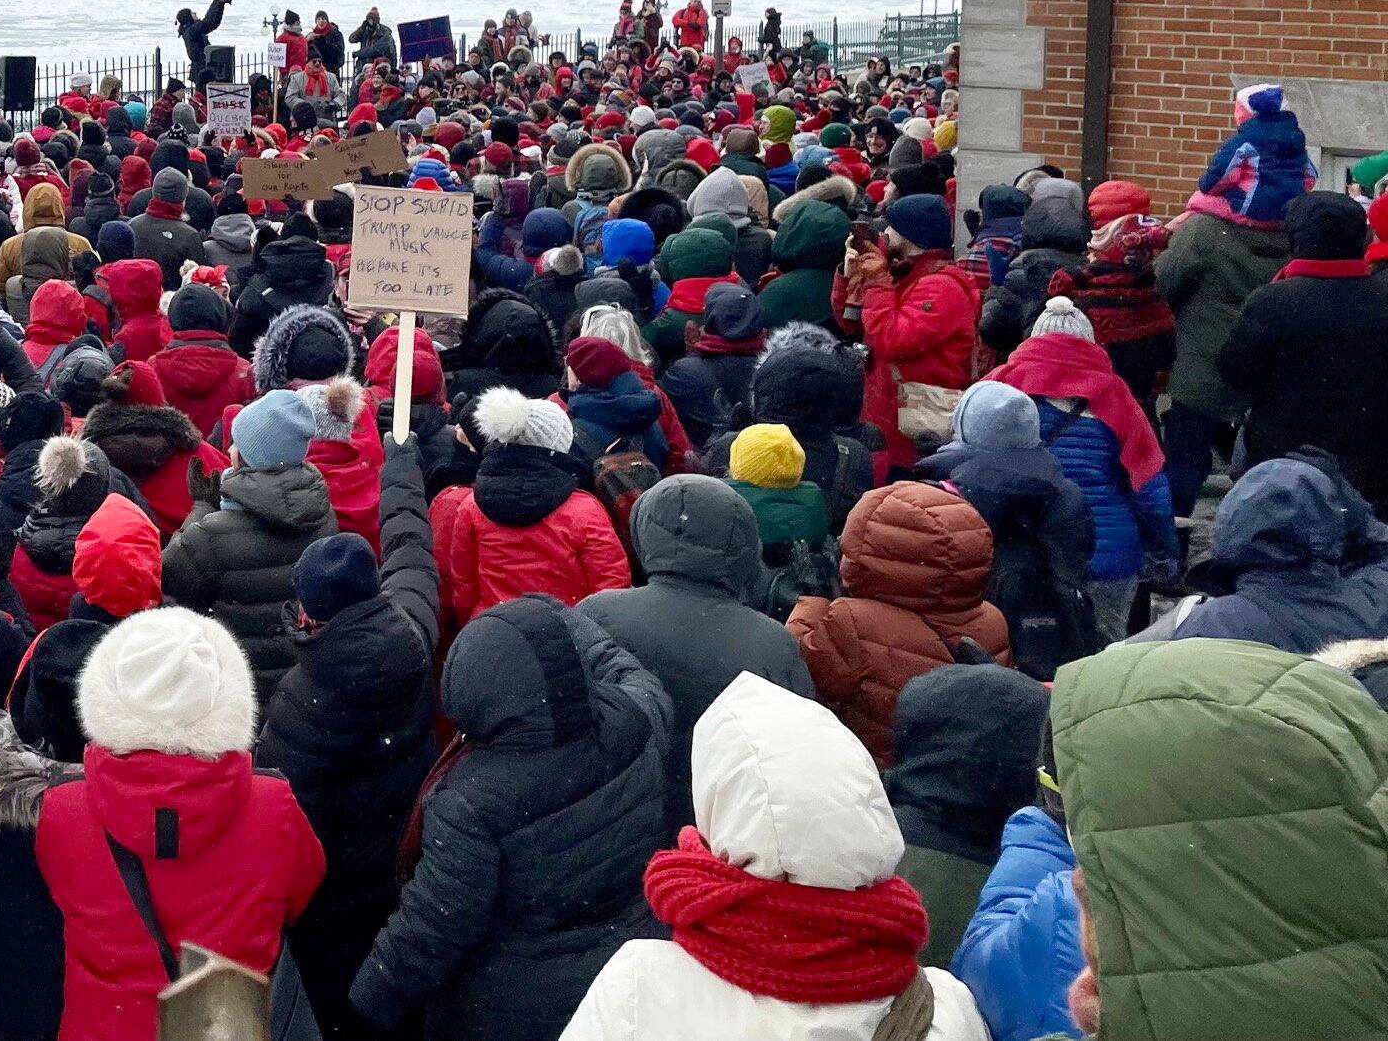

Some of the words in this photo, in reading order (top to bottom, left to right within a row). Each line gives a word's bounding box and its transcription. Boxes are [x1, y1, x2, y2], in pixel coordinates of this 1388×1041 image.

[356, 193, 405, 215] STOP
[411, 197, 469, 216] STUPID
[360, 219, 411, 238] TRUMP
[422, 227, 471, 240] VANCE
[390, 238, 432, 255] MUSK
[356, 257, 409, 273] BEFORE
[418, 262, 440, 277] IT'S
[373, 280, 402, 295] TOO
[413, 282, 453, 296] LATE
